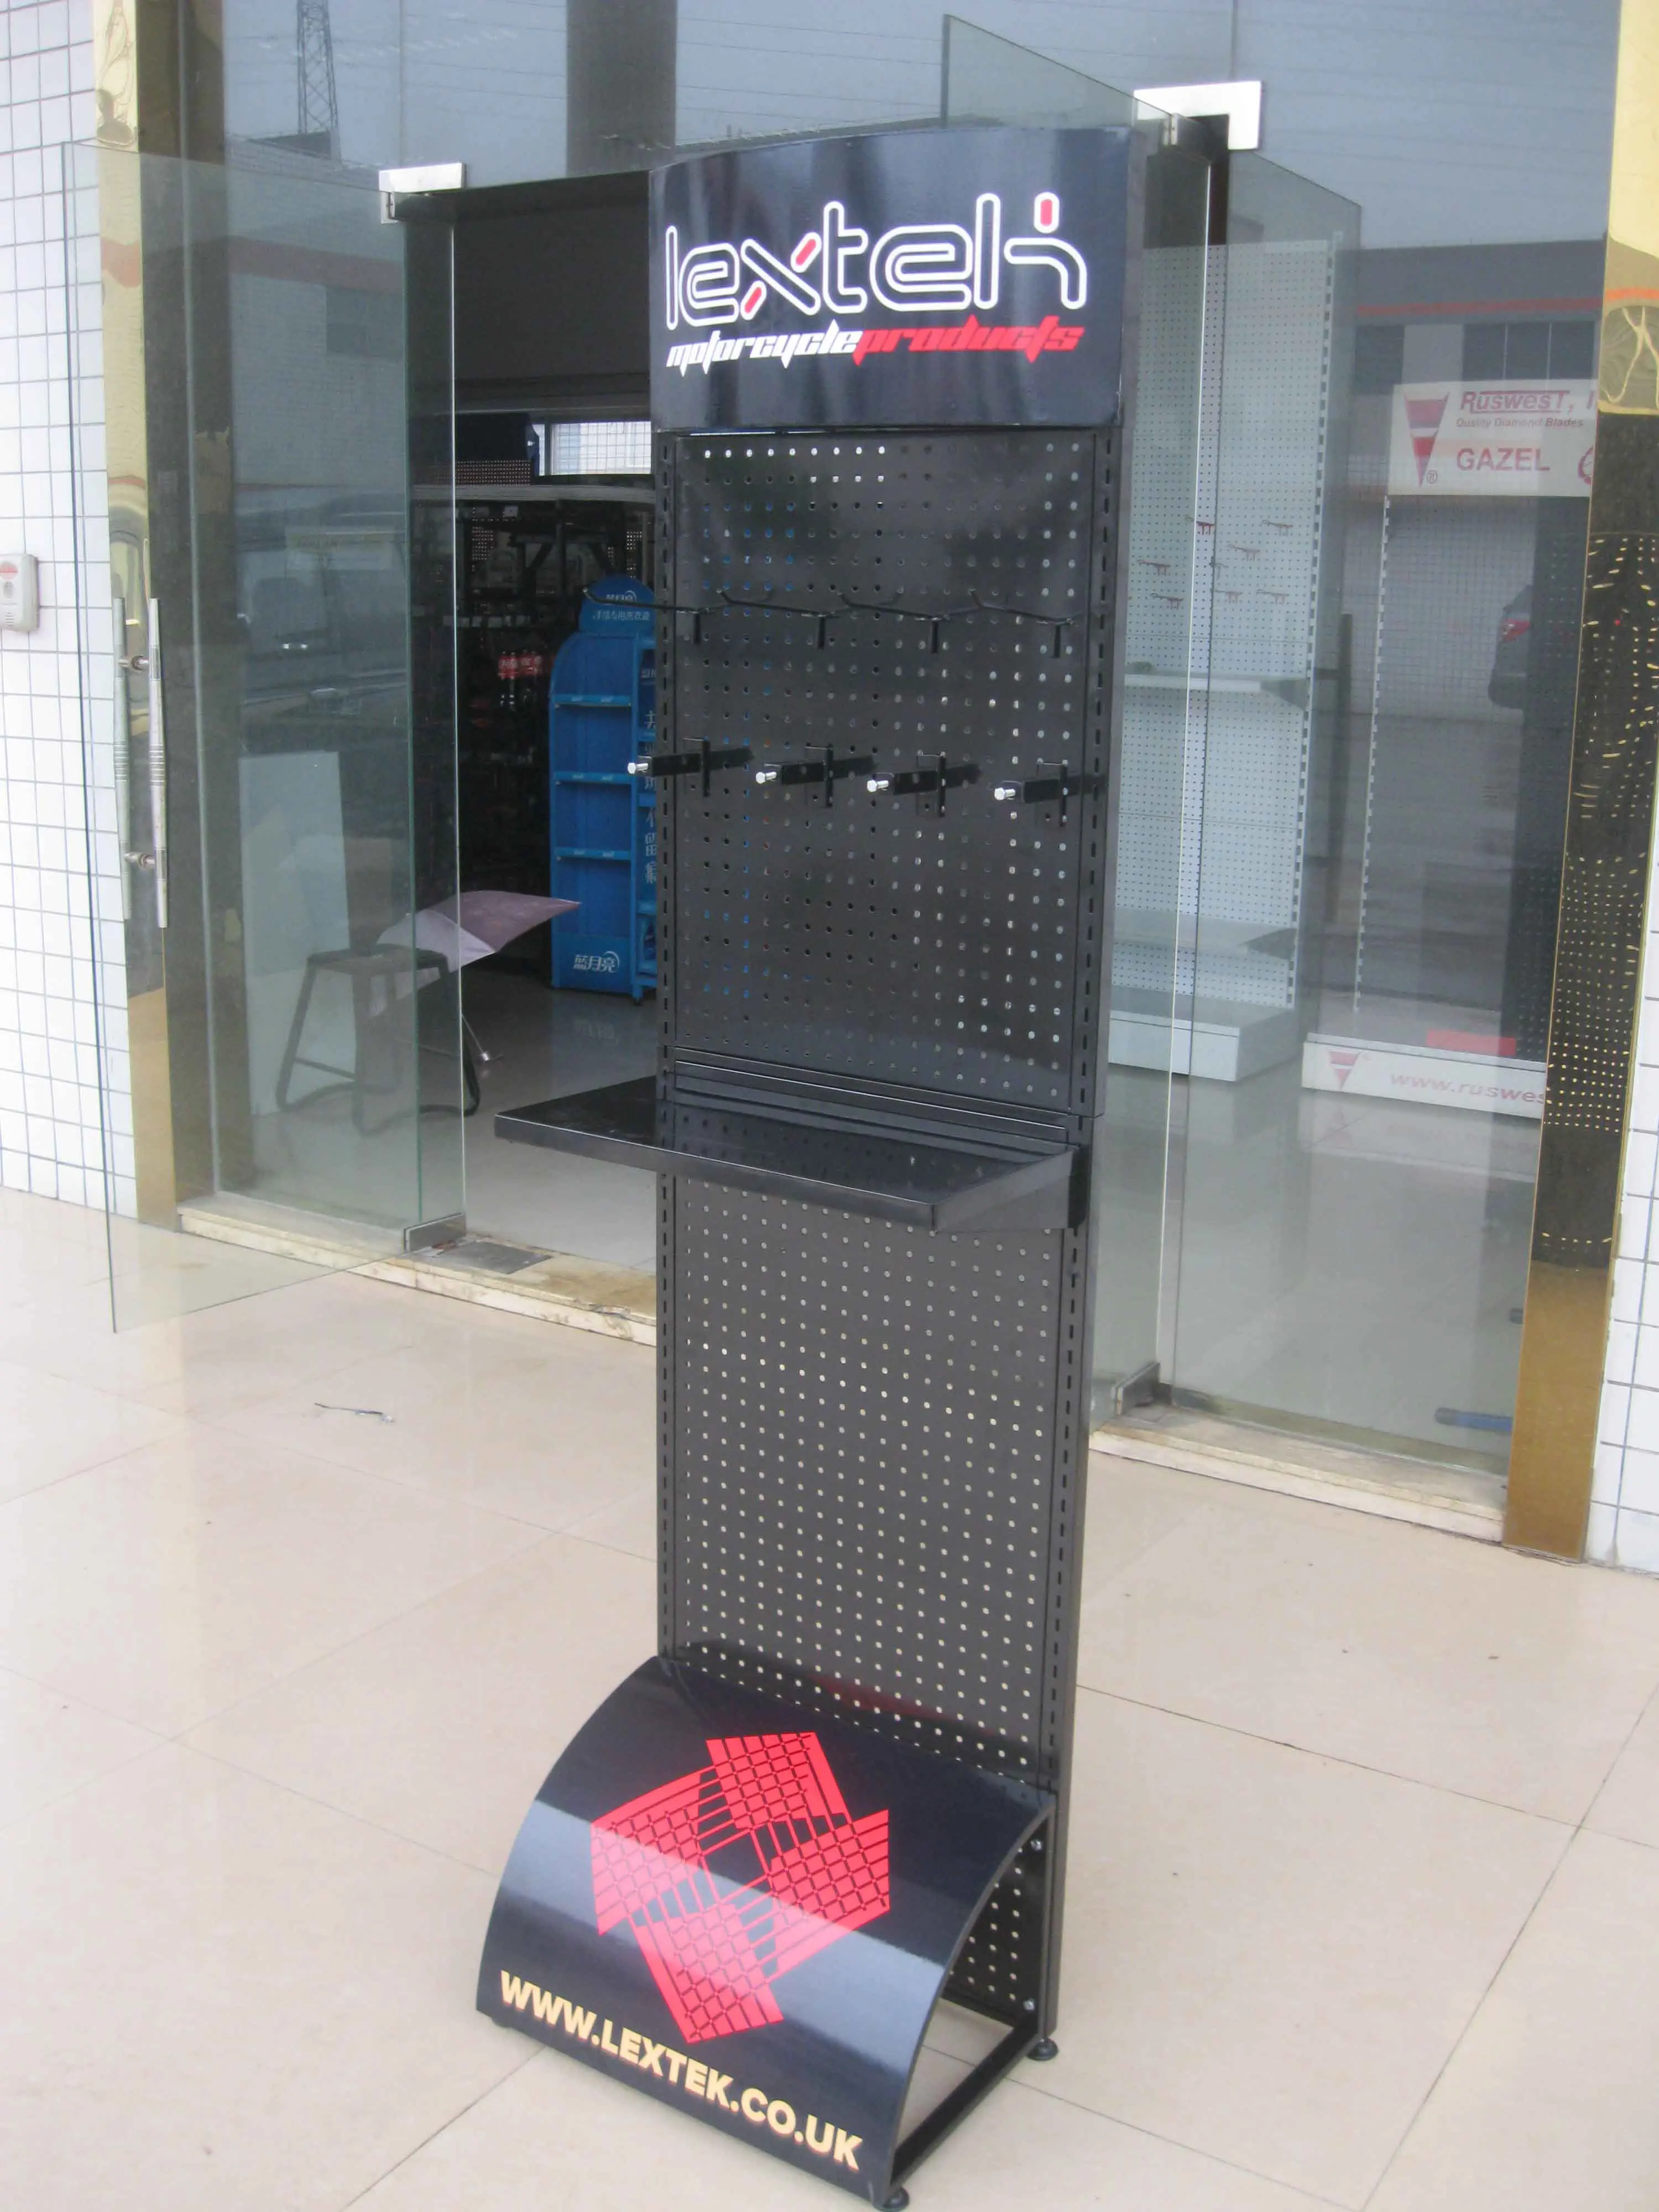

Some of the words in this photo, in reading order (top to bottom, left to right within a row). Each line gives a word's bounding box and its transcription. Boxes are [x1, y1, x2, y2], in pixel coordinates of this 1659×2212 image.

[1455, 418, 1491, 428] Quality
[1494, 418, 1543, 427] Diamond
[1545, 418, 1584, 428] Blades
[1457, 447, 1551, 471] GAZEL
[572, 951, 619, 973] 蓝月亮
[1389, 1071, 1545, 1104] www.ruswes
[500, 1969, 864, 2171] WWW.LEXTEK.CO.UK
